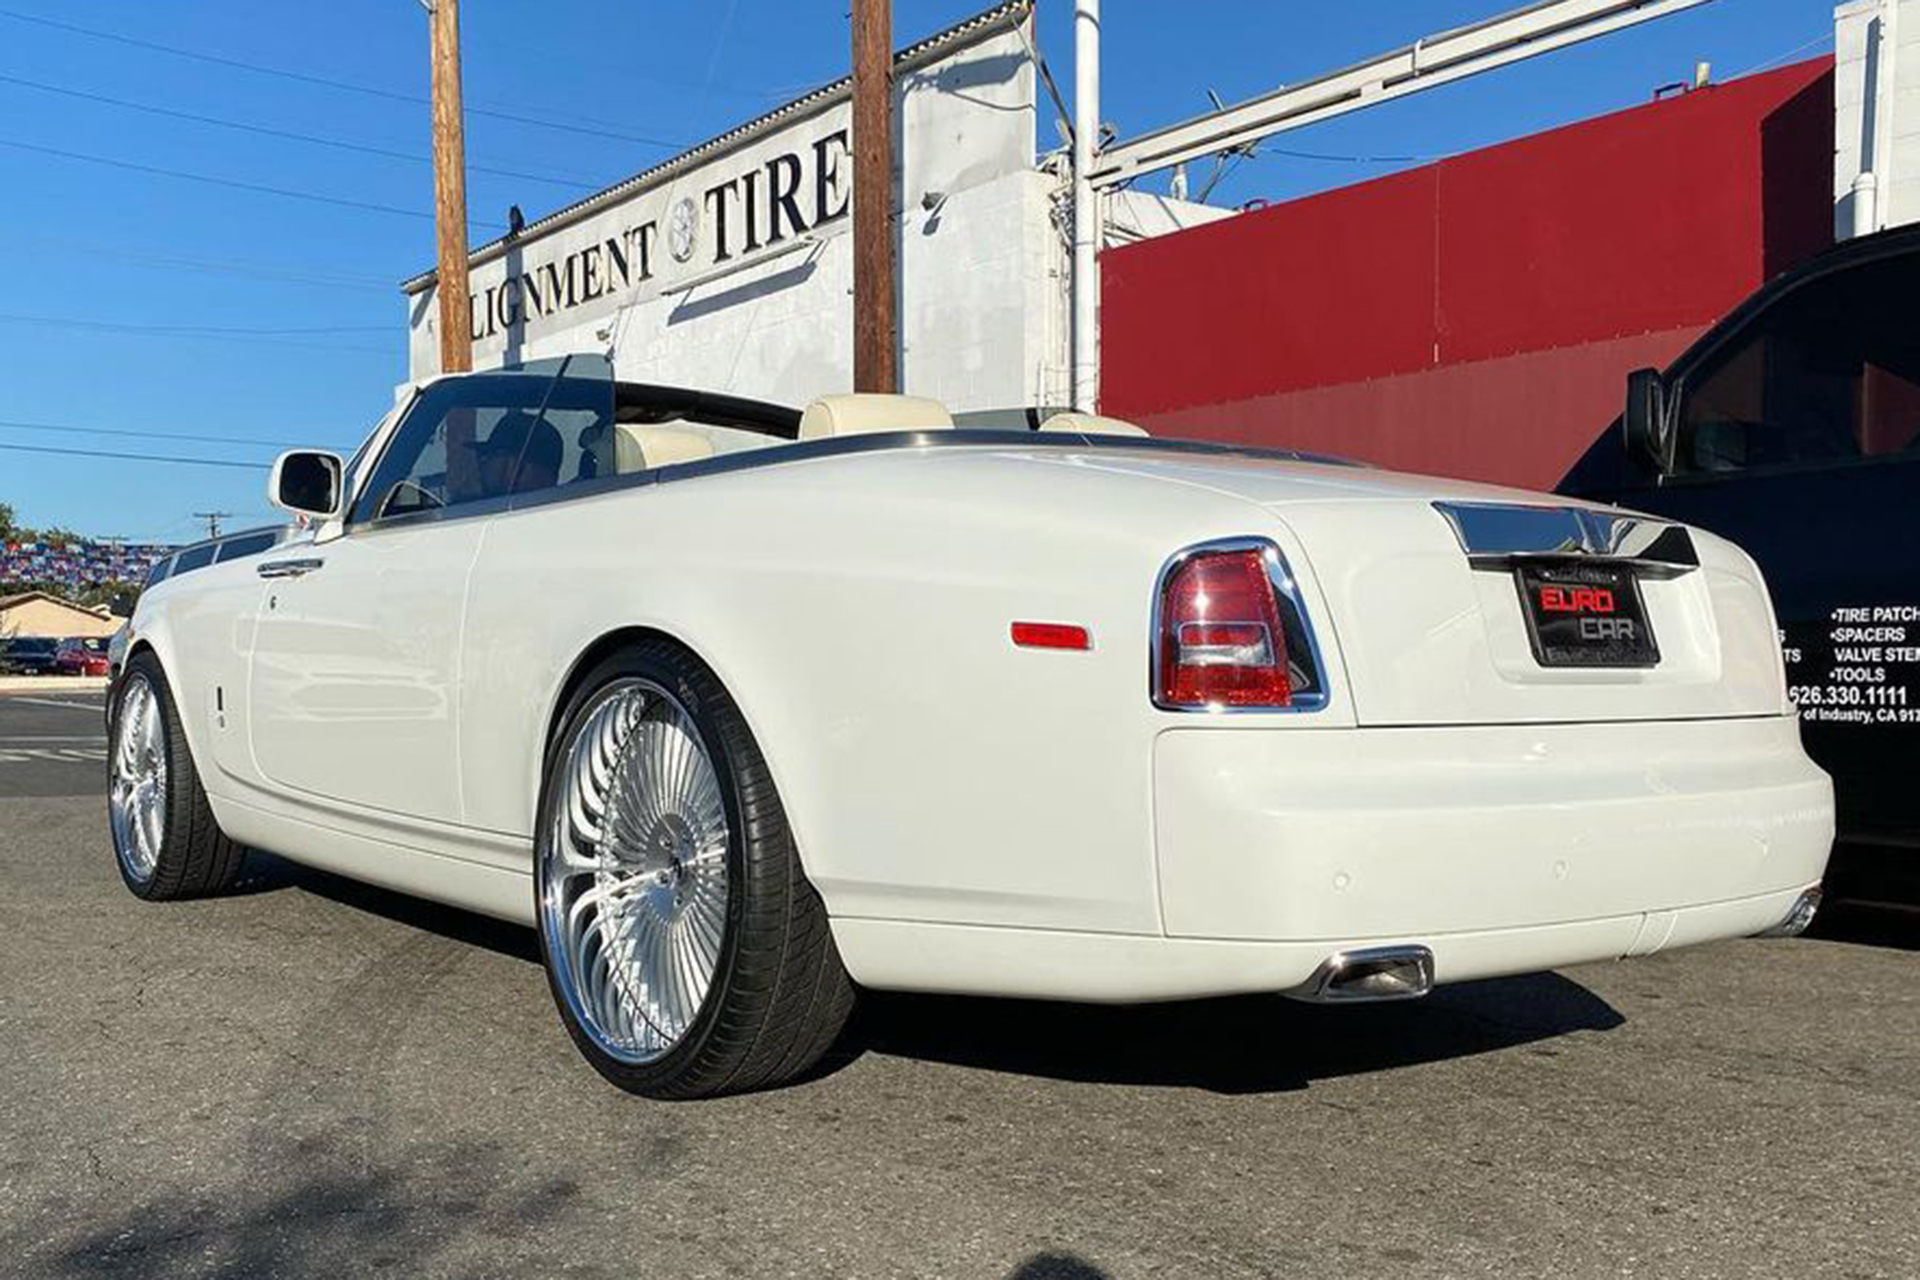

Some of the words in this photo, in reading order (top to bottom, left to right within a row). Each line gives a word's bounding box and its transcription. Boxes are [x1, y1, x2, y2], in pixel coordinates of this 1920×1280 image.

[467, 220, 658, 342] LIGNMENT
[705, 129, 850, 264] TIRE
[1540, 587, 1614, 612] EURO
[1836, 608, 1871, 622] TIRE
[1580, 618, 1635, 640] CAR
[1835, 627, 1906, 642] SPACERS
[1834, 648, 1882, 662] VALVE
[1834, 667, 1886, 682] TOOLS
[1789, 686, 1907, 705] 626.330.1111
[1803, 708, 1817, 720] of
[1819, 708, 1874, 724] Industry,
[1876, 708, 1898, 722] CA
